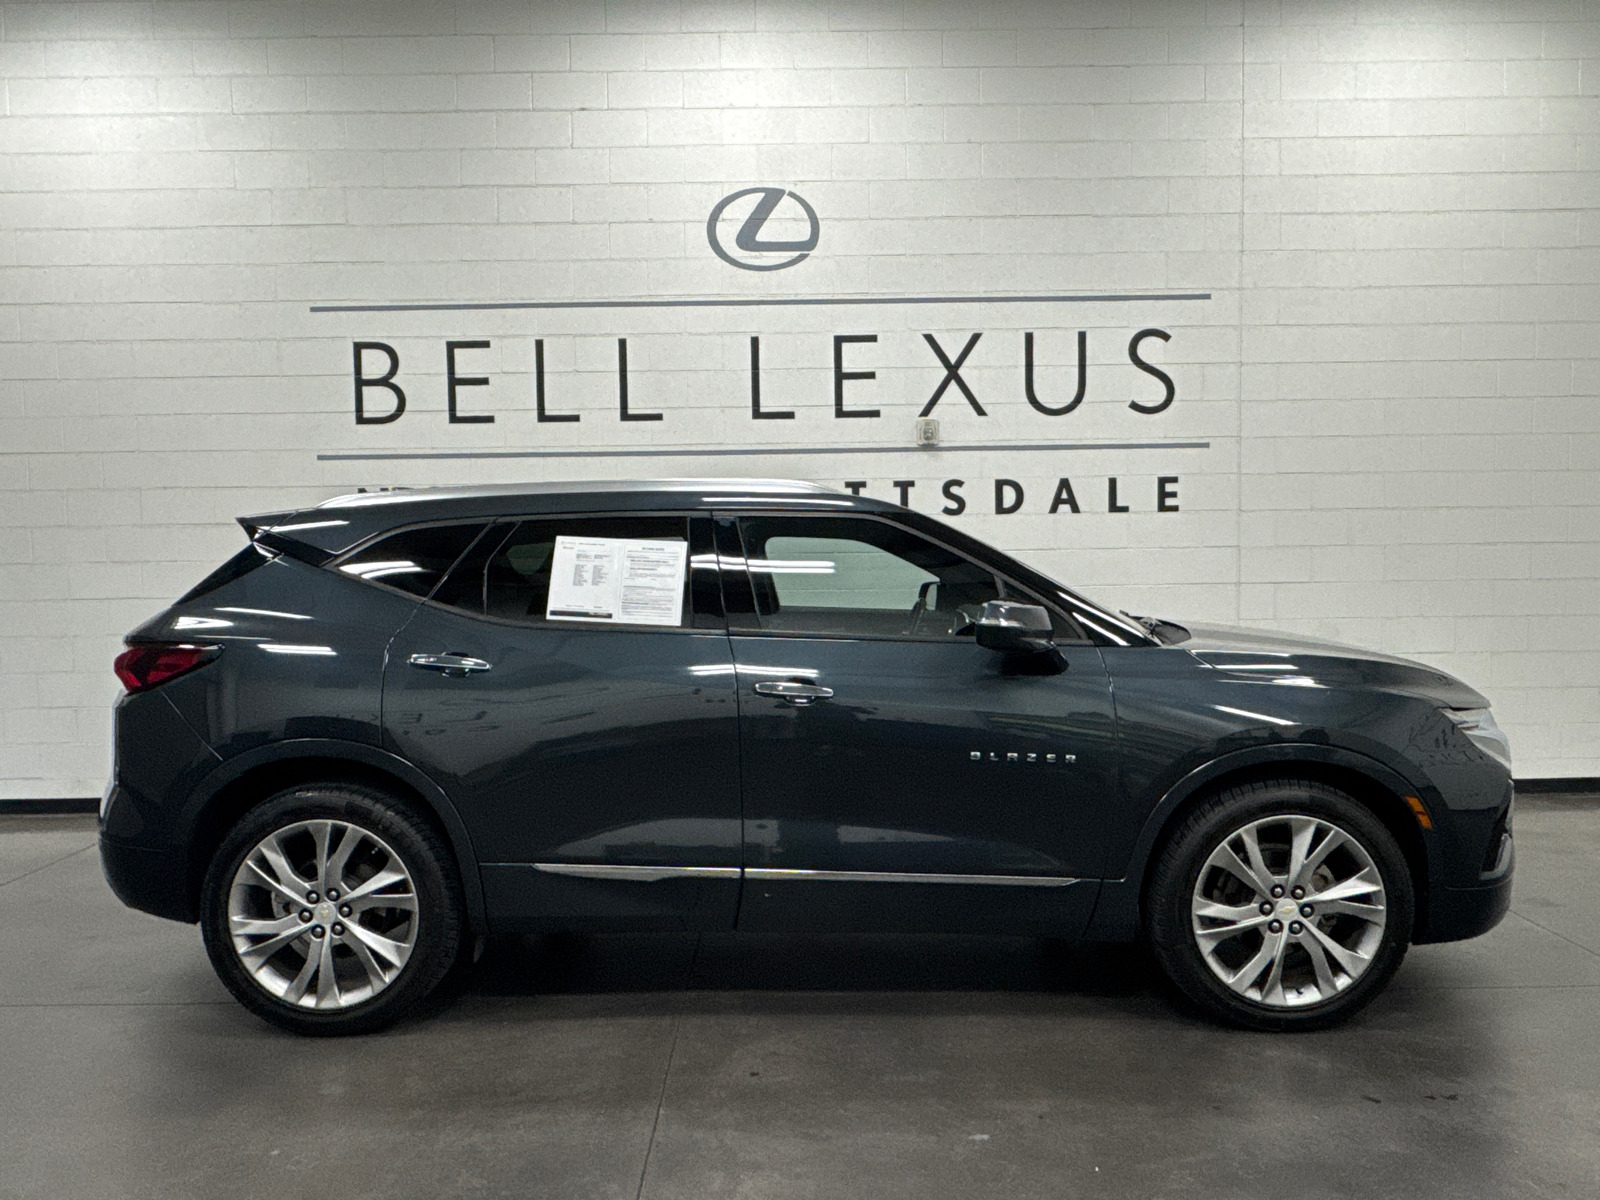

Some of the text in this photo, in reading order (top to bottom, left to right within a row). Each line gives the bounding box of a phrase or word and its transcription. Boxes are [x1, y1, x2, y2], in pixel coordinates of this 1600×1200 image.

[353, 328, 1176, 425] BELL LEXUS
[969, 751, 1077, 764] BLAZER
